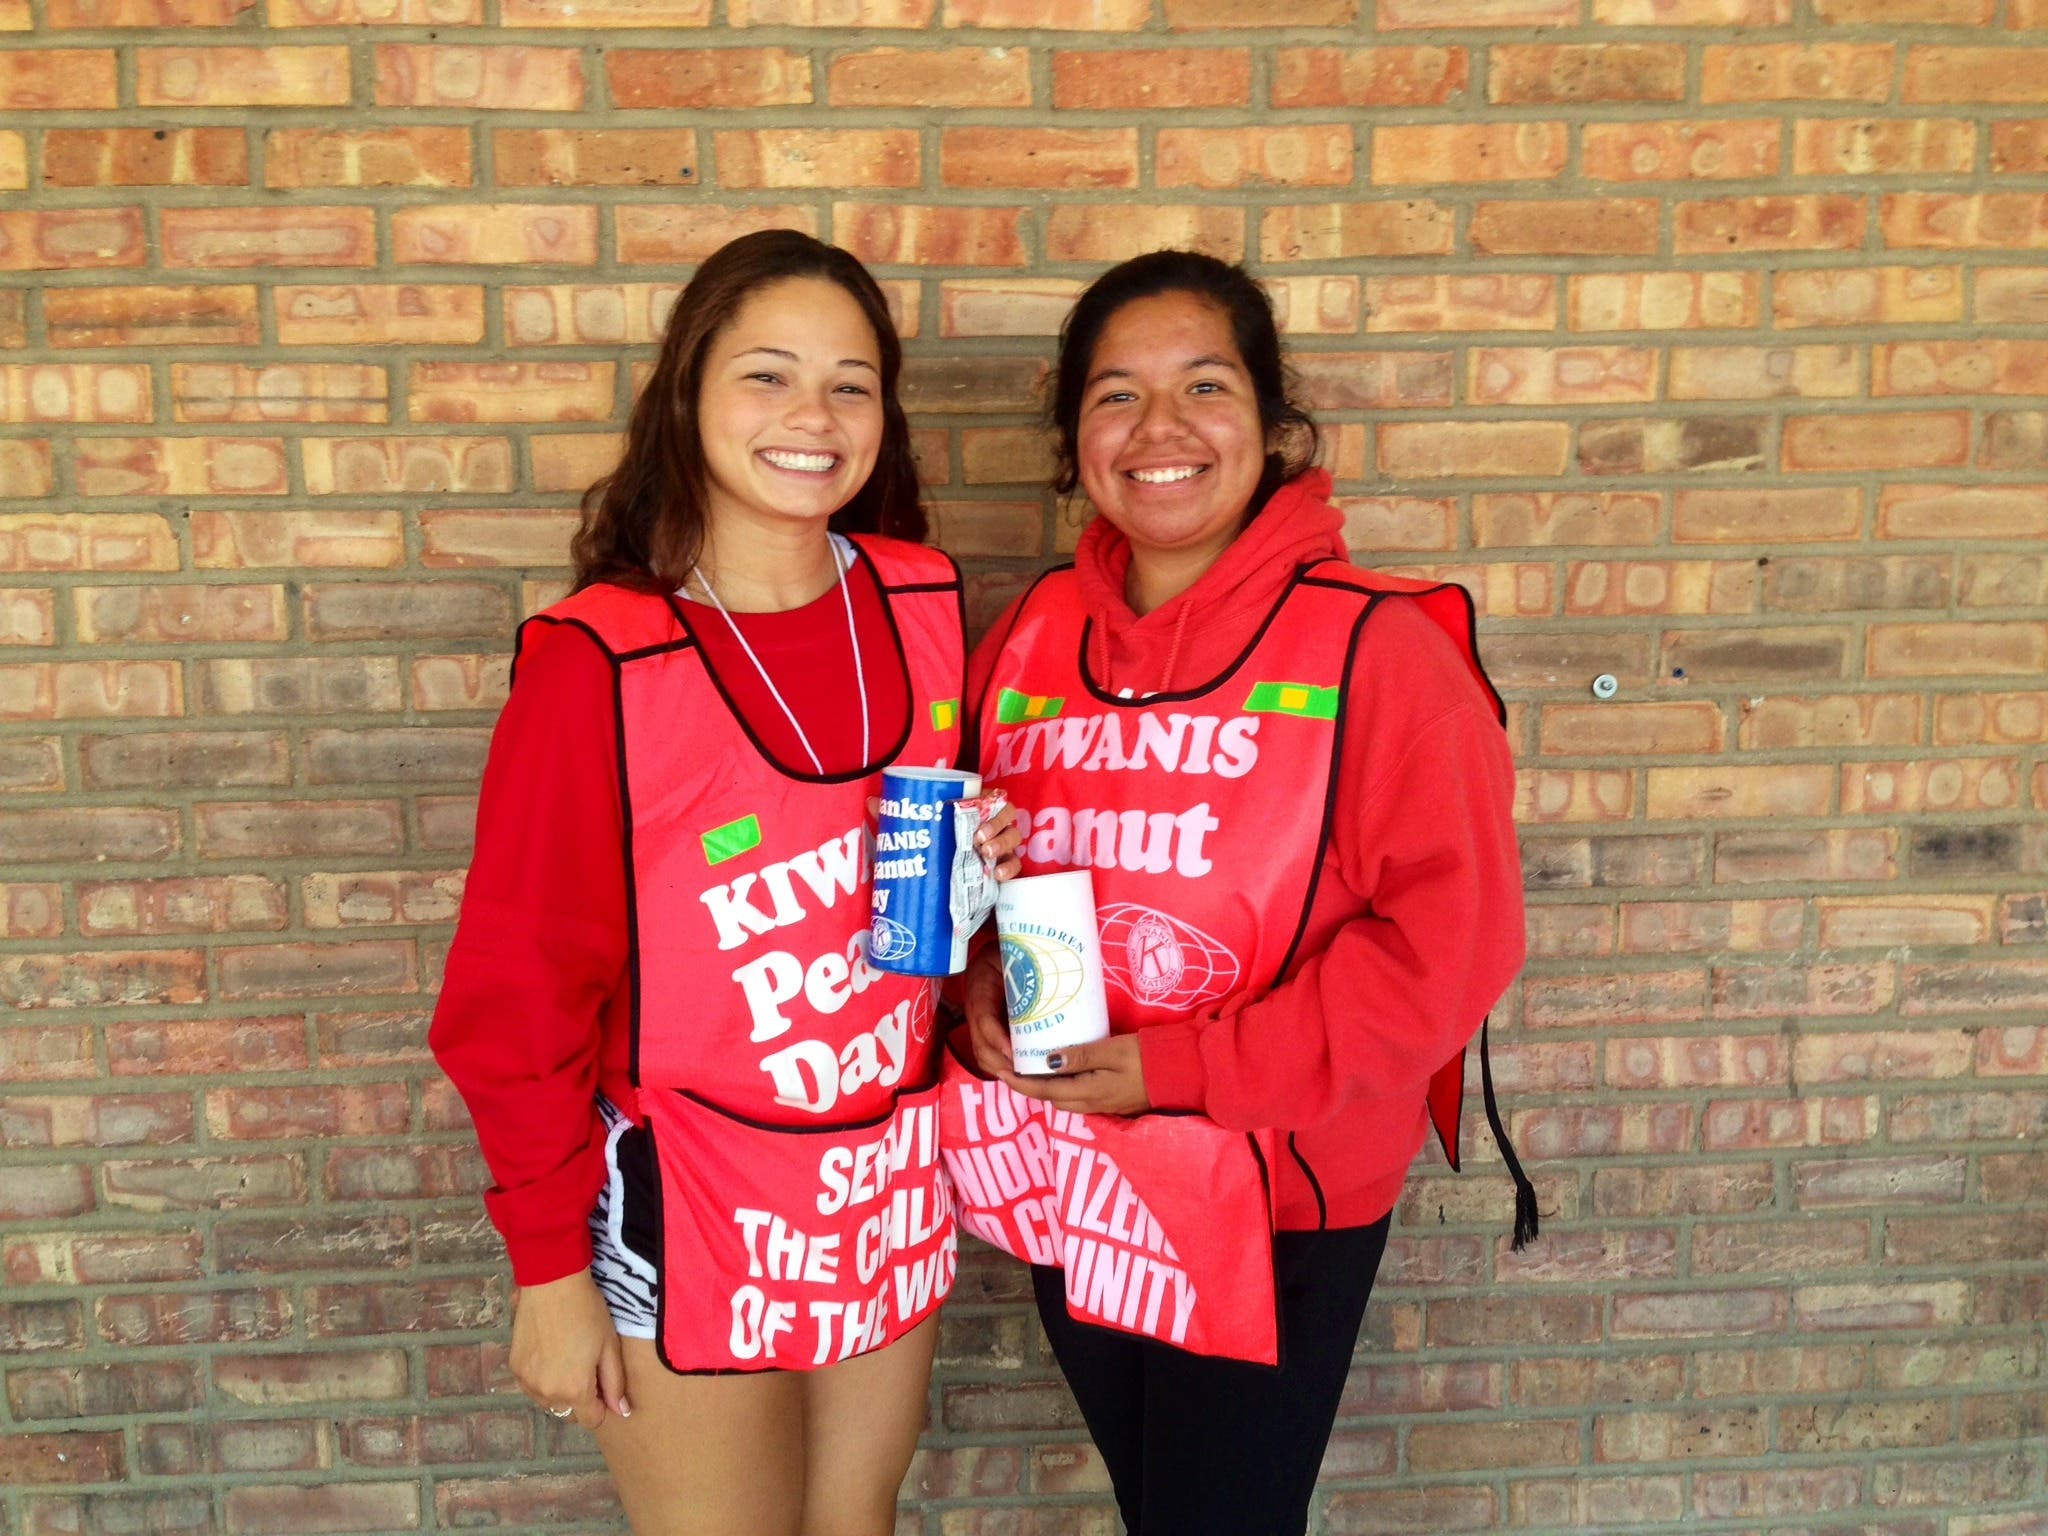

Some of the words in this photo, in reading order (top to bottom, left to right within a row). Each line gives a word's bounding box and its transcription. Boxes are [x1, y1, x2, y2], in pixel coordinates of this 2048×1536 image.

[984, 711, 1260, 782] KIWANIS
[699, 820, 872, 951] KIW
[1009, 922, 1086, 954] CHILDREN
[759, 999, 910, 1114] Day
[1014, 1012, 1066, 1037] WORLD
[733, 1207, 841, 1284] THE
[728, 1284, 797, 1360] OF
[808, 1278, 889, 1366] THE
